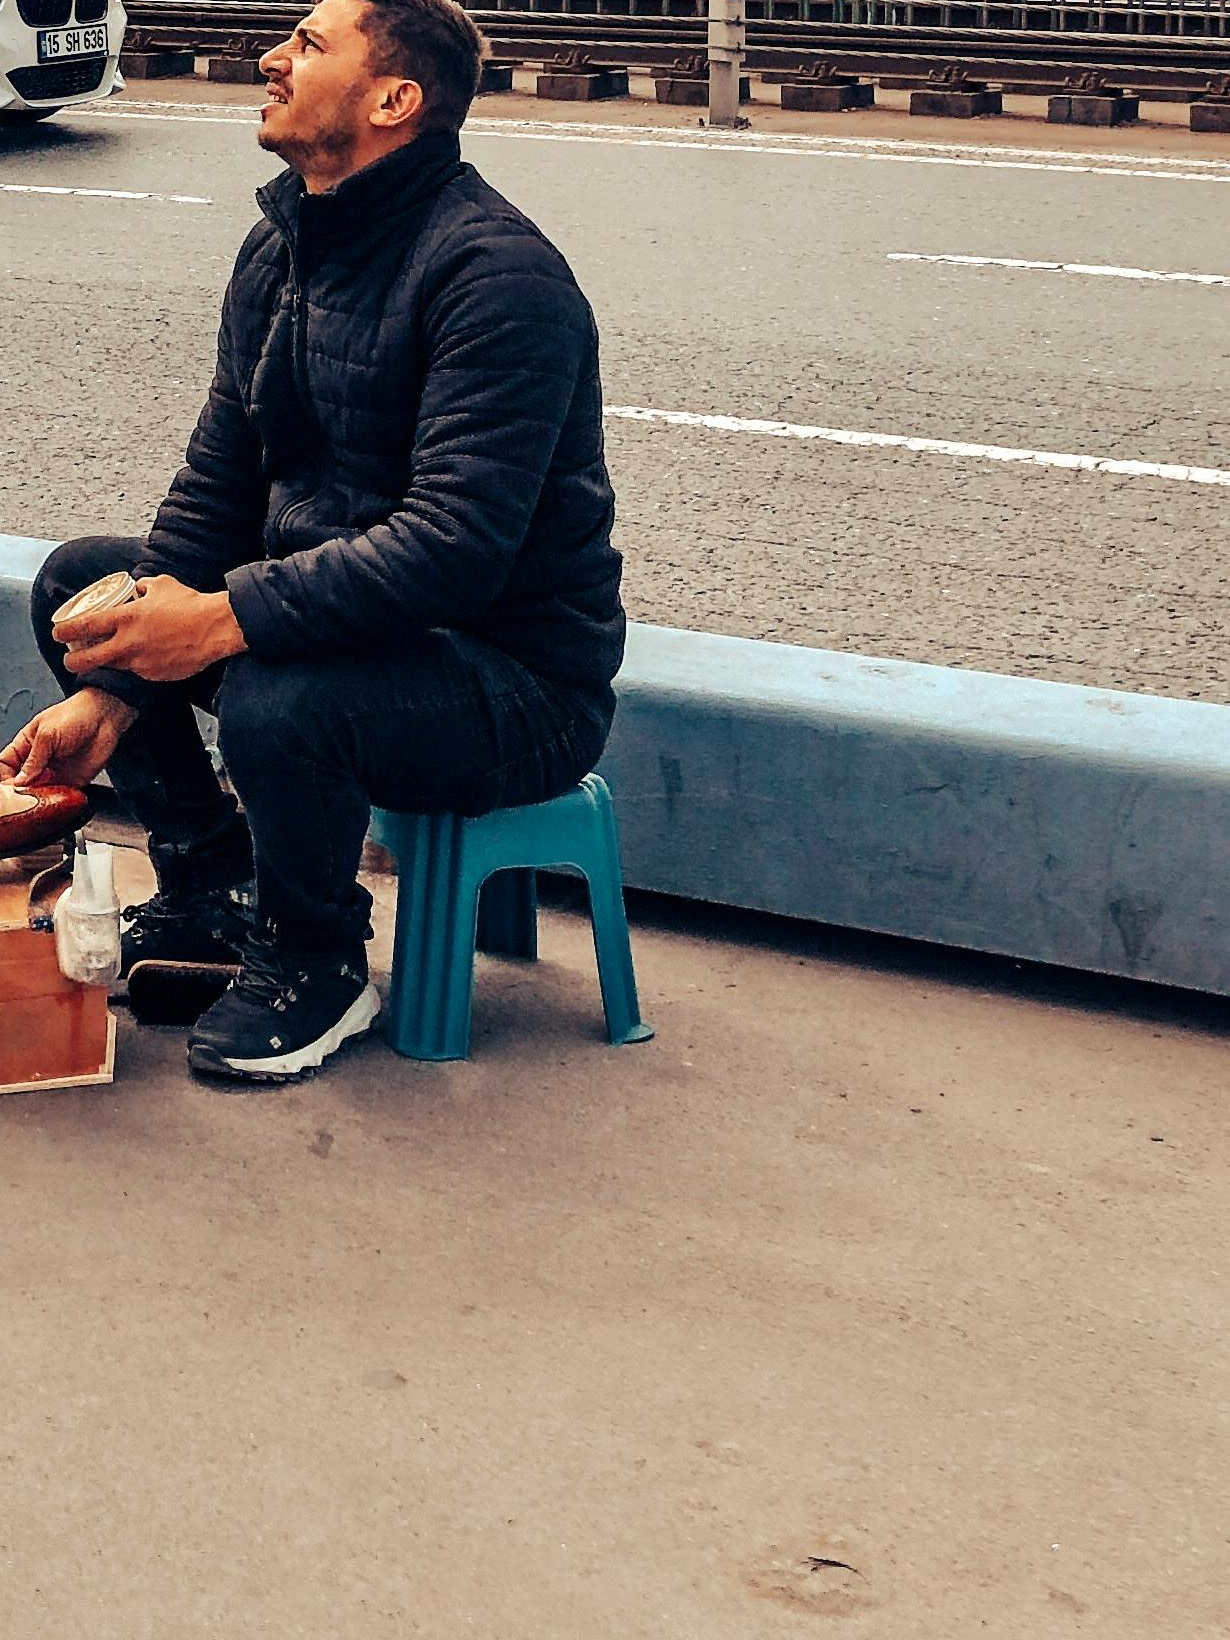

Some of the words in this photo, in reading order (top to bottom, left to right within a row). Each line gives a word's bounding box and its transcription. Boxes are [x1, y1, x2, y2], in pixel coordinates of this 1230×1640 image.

[47, 34, 60, 55] 15
[65, 31, 81, 53] SH
[83, 28, 105, 50] 636
